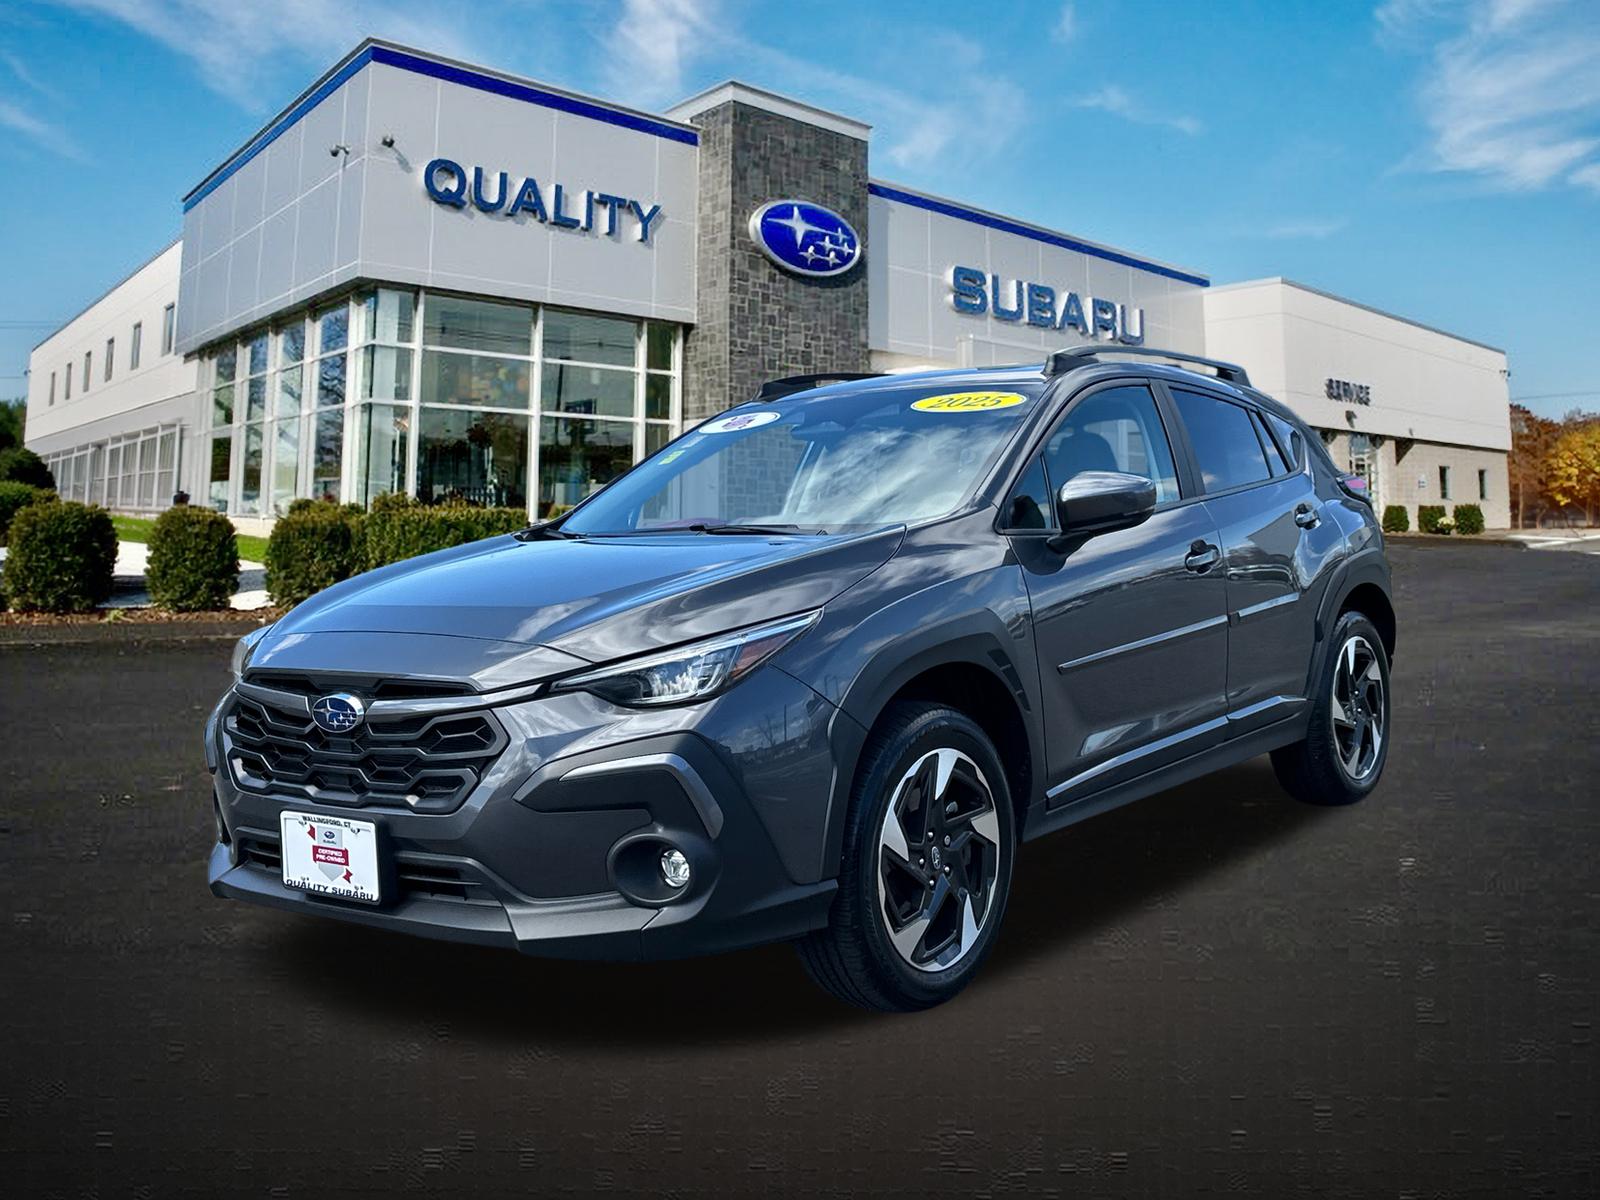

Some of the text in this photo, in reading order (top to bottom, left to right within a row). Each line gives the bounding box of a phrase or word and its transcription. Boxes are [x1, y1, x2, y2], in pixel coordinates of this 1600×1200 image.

[424, 158, 662, 242] QUALITY
[951, 265, 1145, 346] SUBARU
[926, 395, 1011, 409] 2025
[1325, 378, 1371, 406] SERVICE
[286, 879, 374, 900] QUALITY SUBARU
